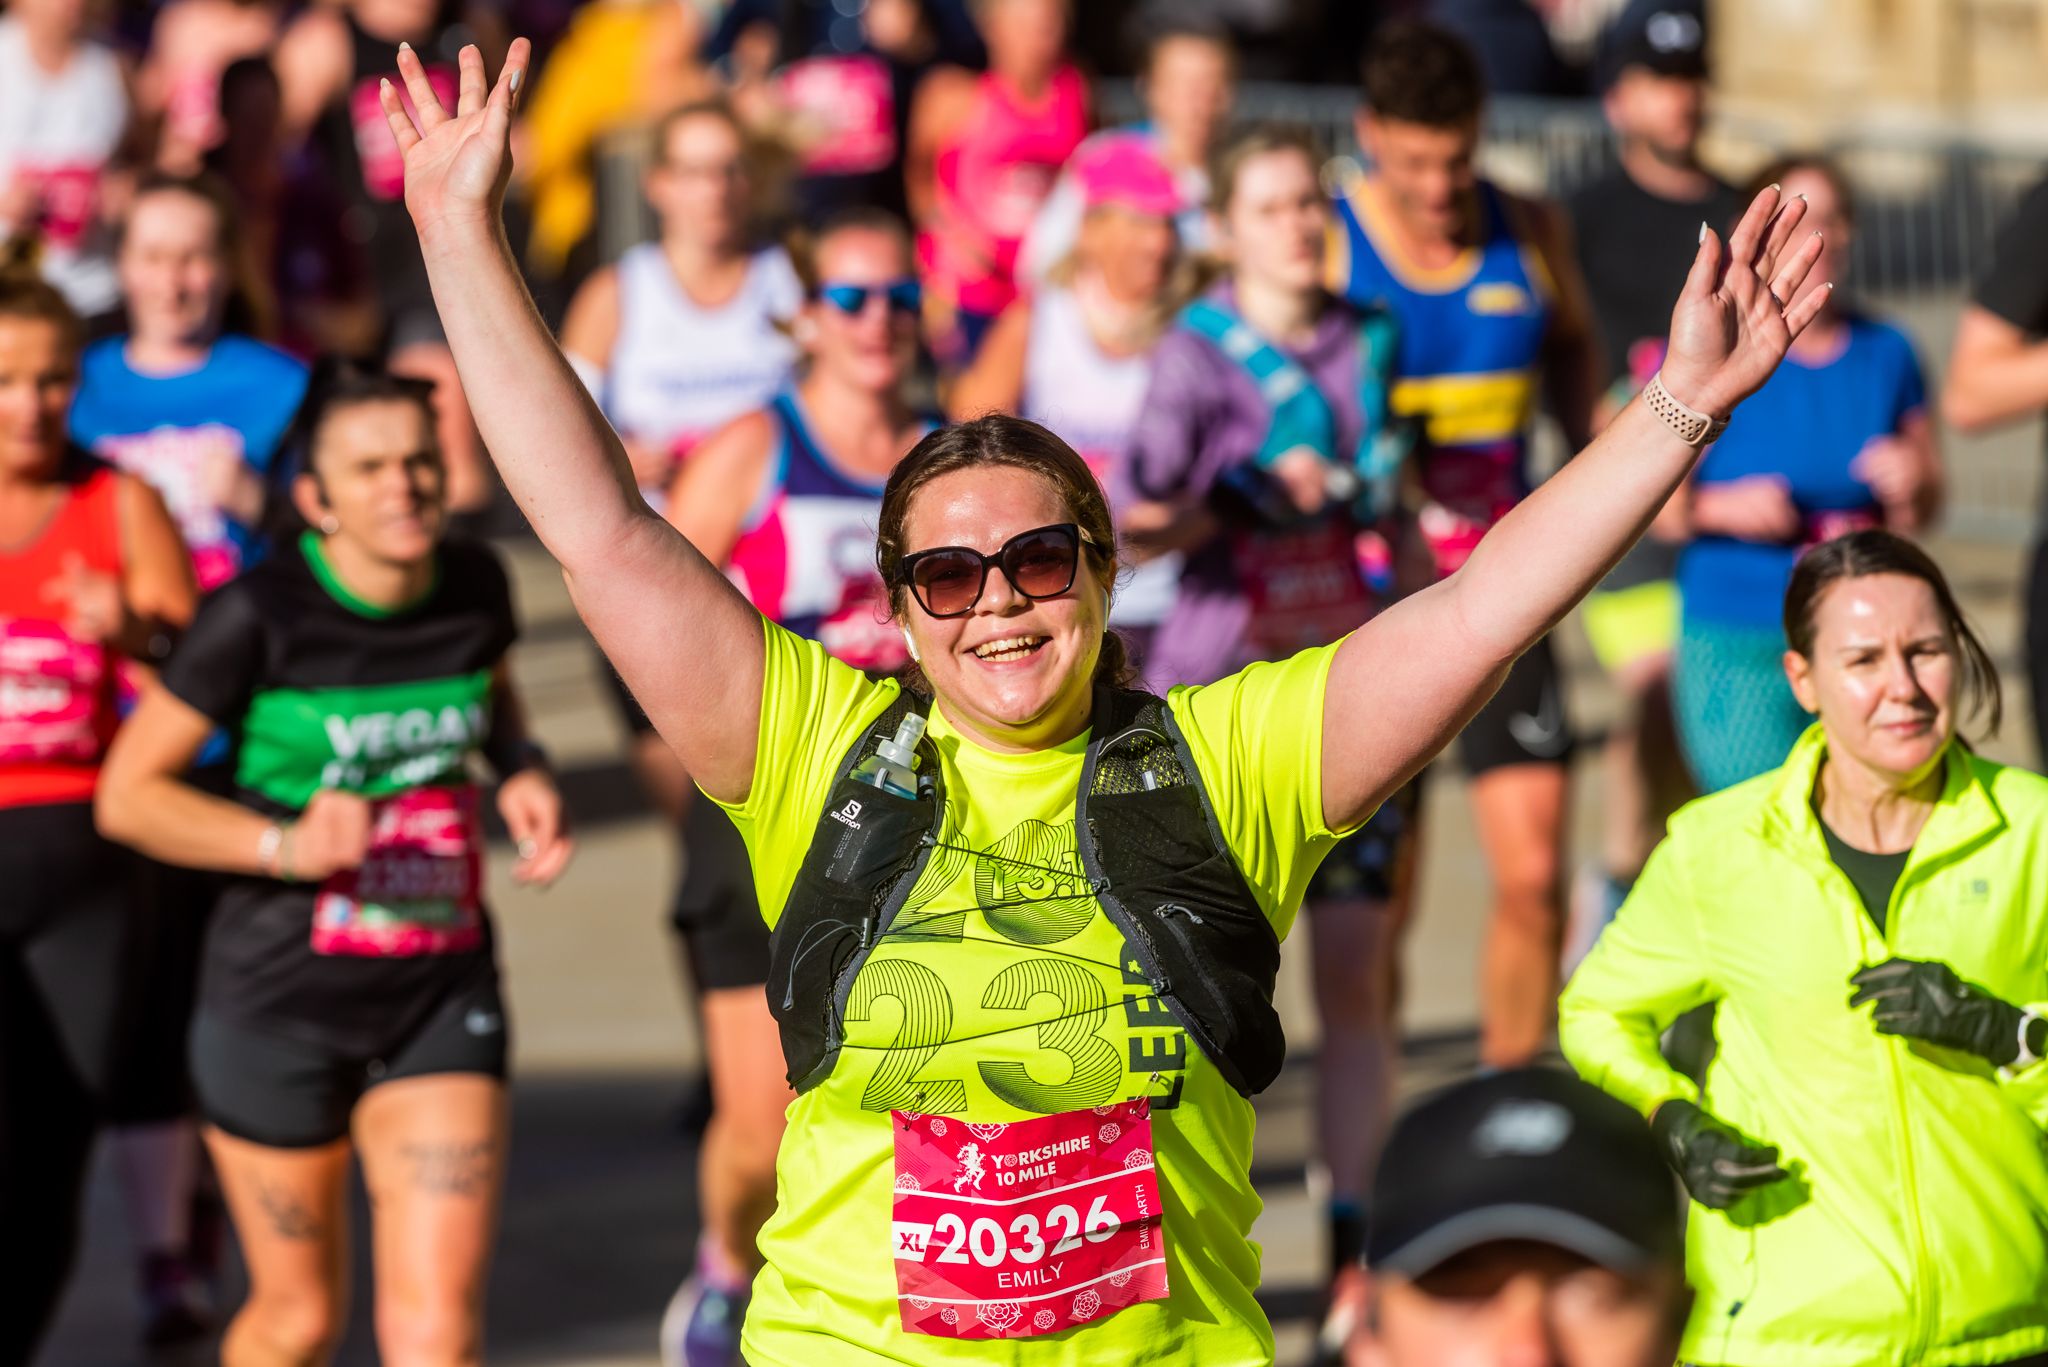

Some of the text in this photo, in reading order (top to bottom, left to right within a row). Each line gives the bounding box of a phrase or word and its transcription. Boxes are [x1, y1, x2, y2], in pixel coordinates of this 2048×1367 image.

[843, 958, 1122, 1115] 23
[991, 1136, 1091, 1169] YORKSHIRE
[996, 1161, 1057, 1187] 10 MILE
[935, 1195, 1121, 1268] 20326
[1134, 1184, 1150, 1250] EMILY GARTH
[900, 1232, 927, 1253] XL
[998, 1262, 1064, 1289] EMILY
